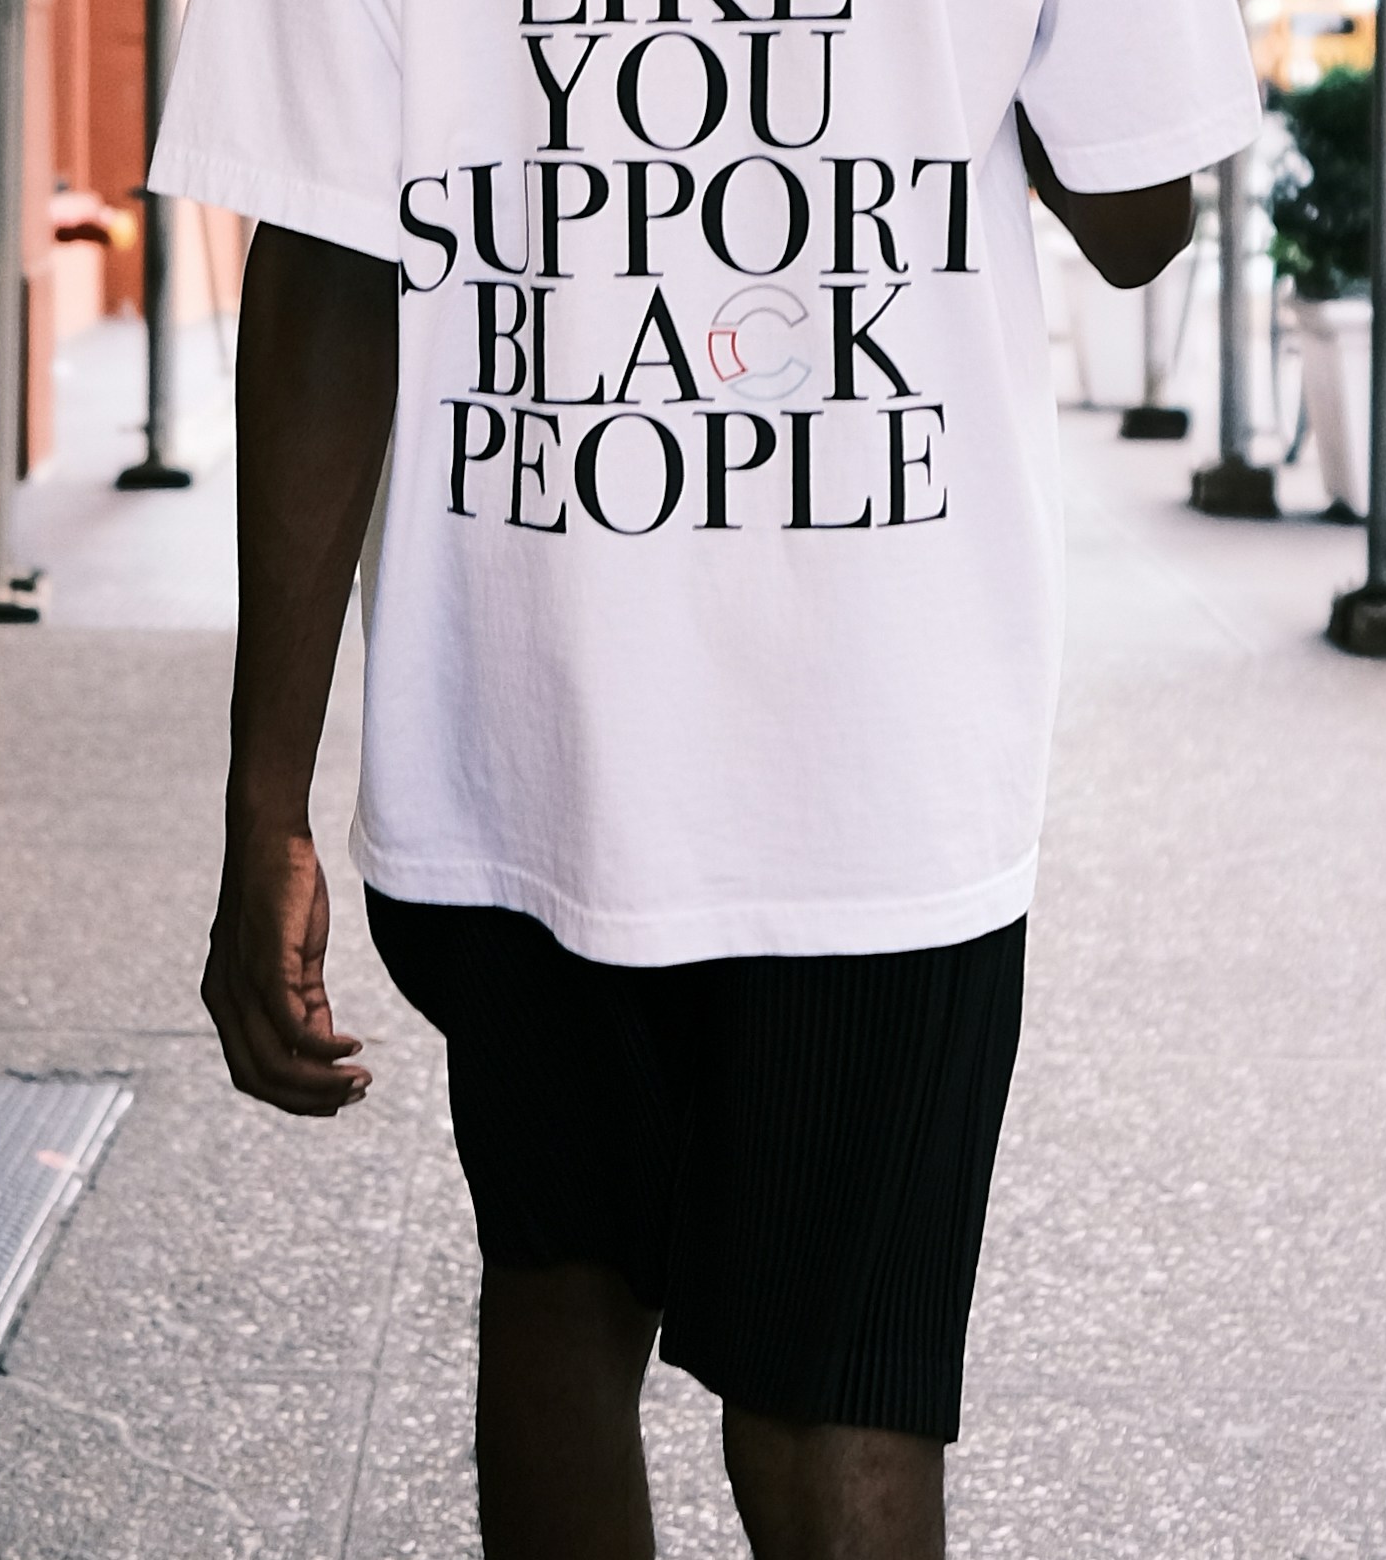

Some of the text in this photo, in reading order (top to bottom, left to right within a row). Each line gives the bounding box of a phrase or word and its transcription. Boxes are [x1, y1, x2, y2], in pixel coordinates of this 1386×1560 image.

[521, 30, 834, 151] YOU
[399, 154, 980, 296] SUPPORT
[465, 279, 921, 405] BLACK
[444, 401, 947, 533] PEOPLE
